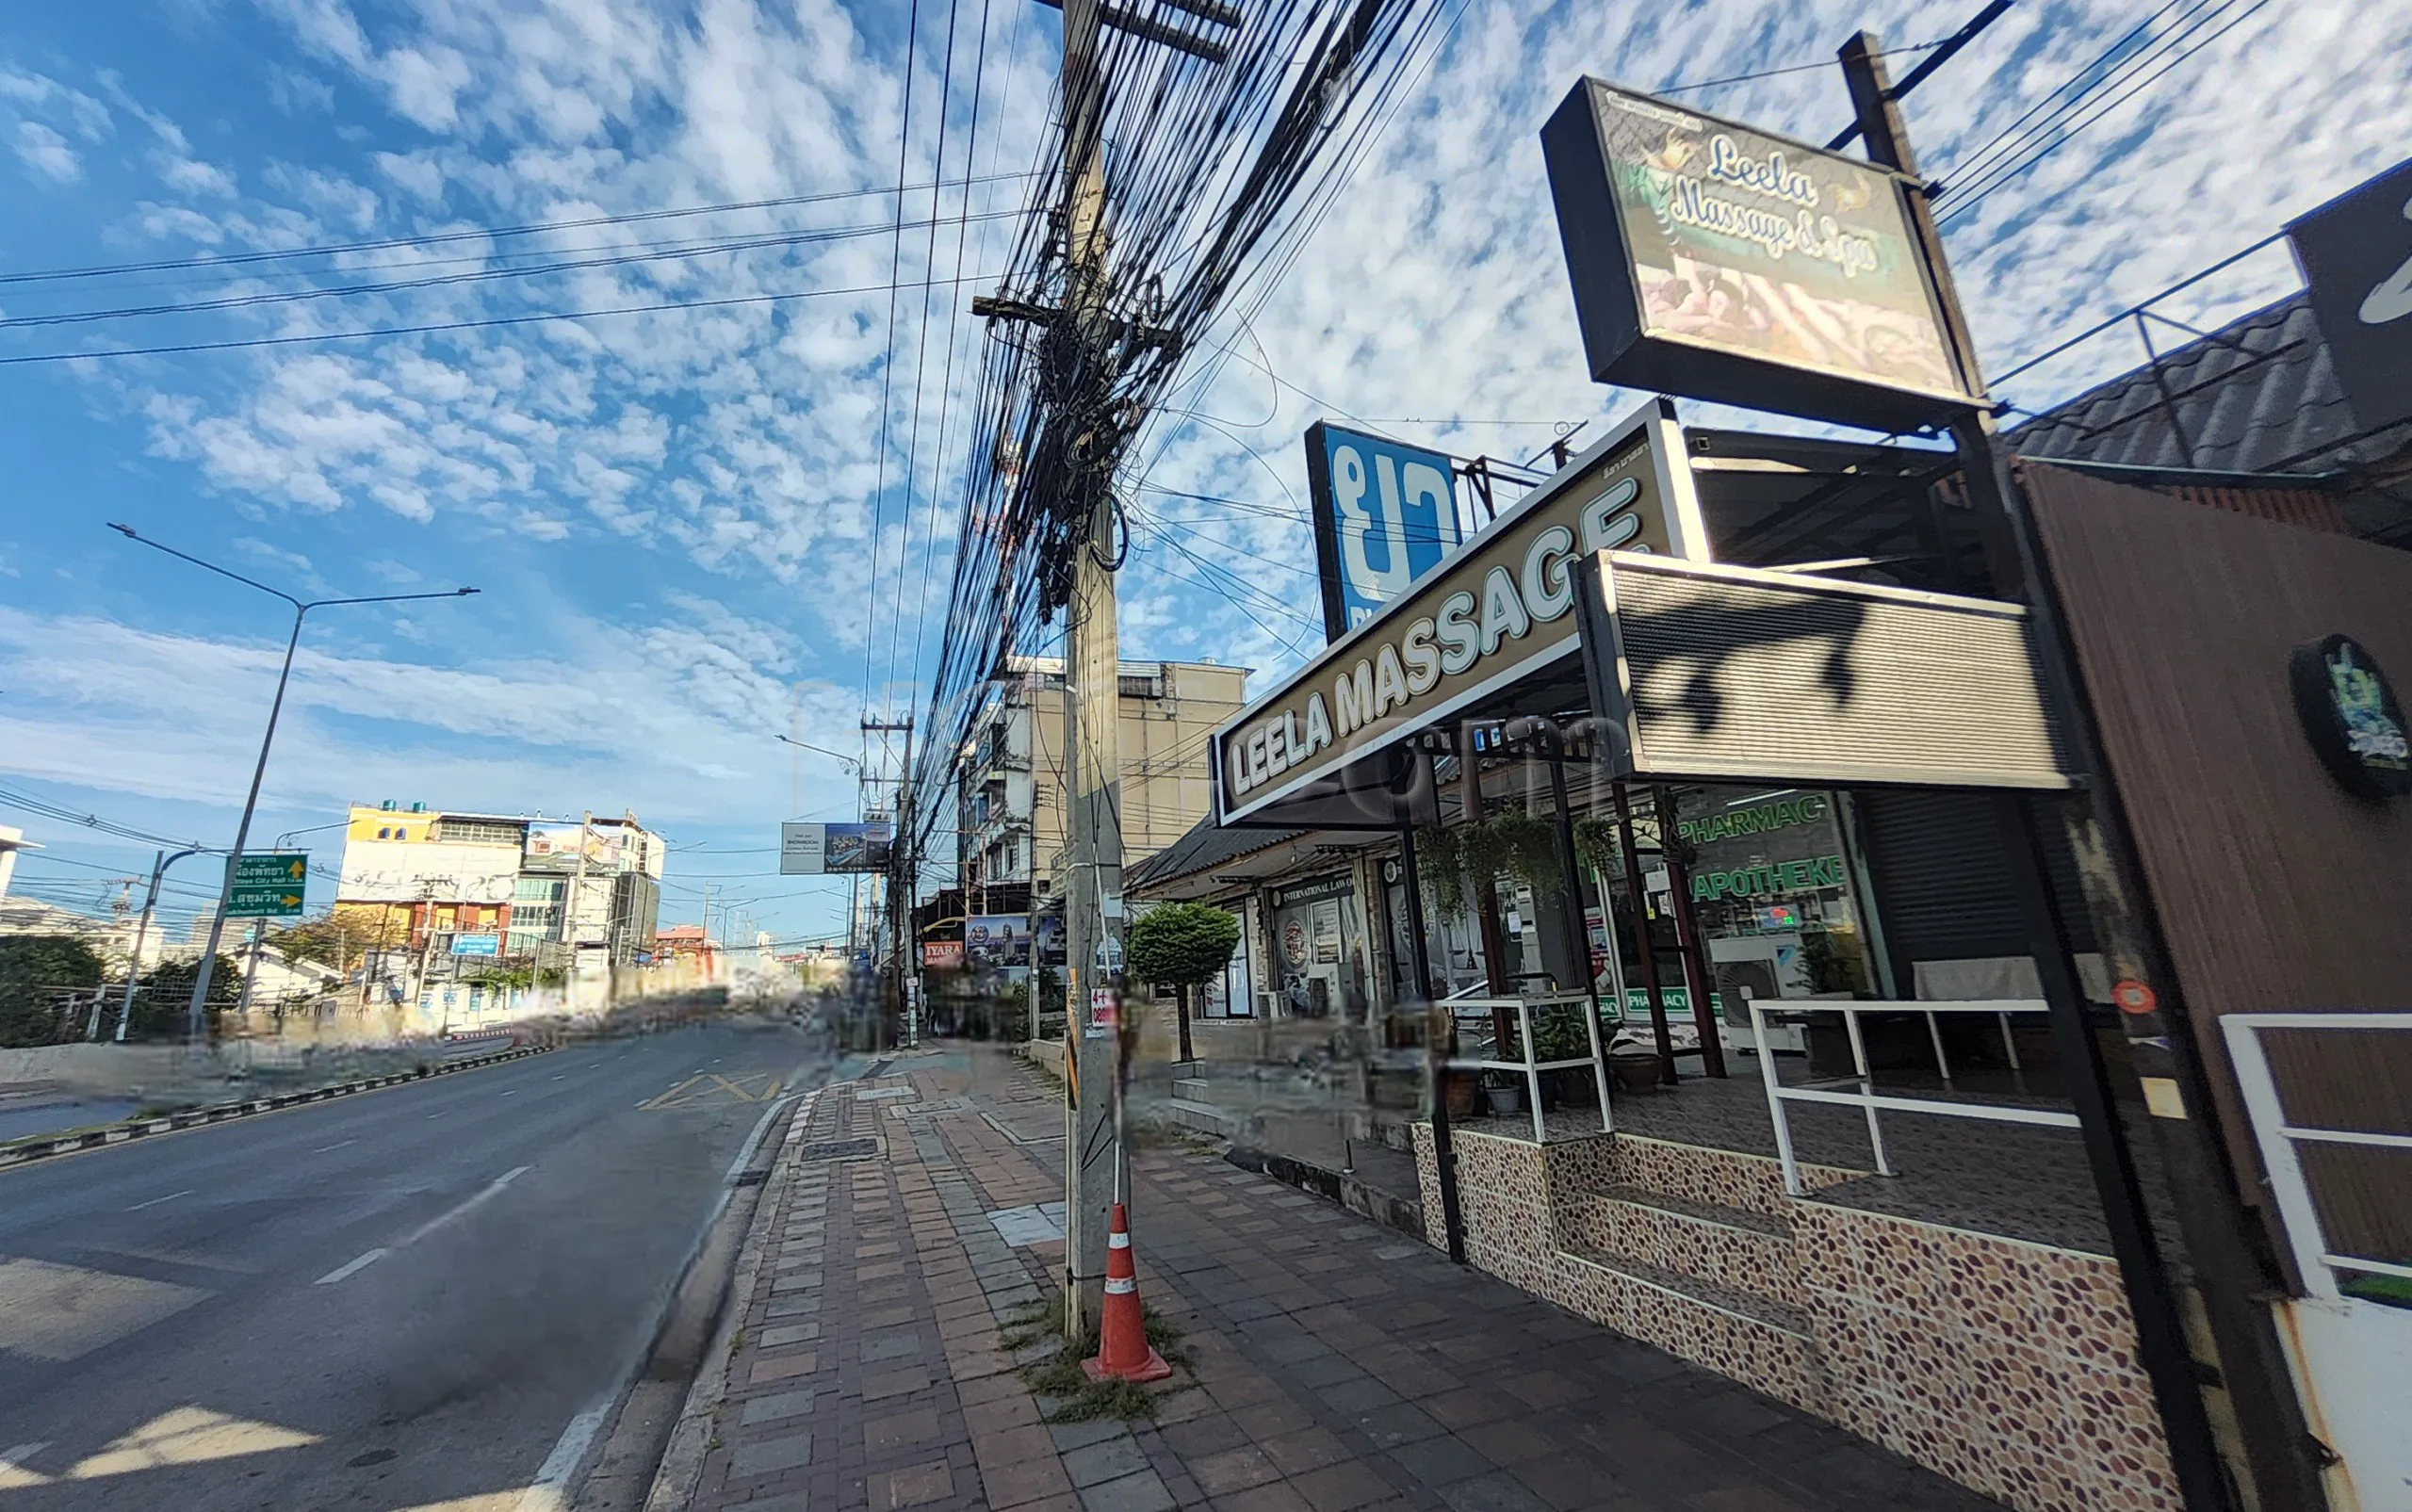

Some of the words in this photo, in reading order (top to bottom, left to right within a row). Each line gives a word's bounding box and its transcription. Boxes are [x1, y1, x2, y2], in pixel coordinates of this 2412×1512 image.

[1707, 134, 1819, 207] Leela
[1670, 174, 1796, 259] Massage
[1796, 209, 1823, 257] &
[1820, 216, 1877, 278] Spa
[1332, 445, 1458, 604] ยา
[1231, 691, 1331, 795] LEELA
[1334, 476, 1651, 738] MASSAGE
[1283, 885, 1329, 902] INTERNATIONAL
[1329, 879, 1345, 893] LAW
[925, 943, 961, 955] IYARA
